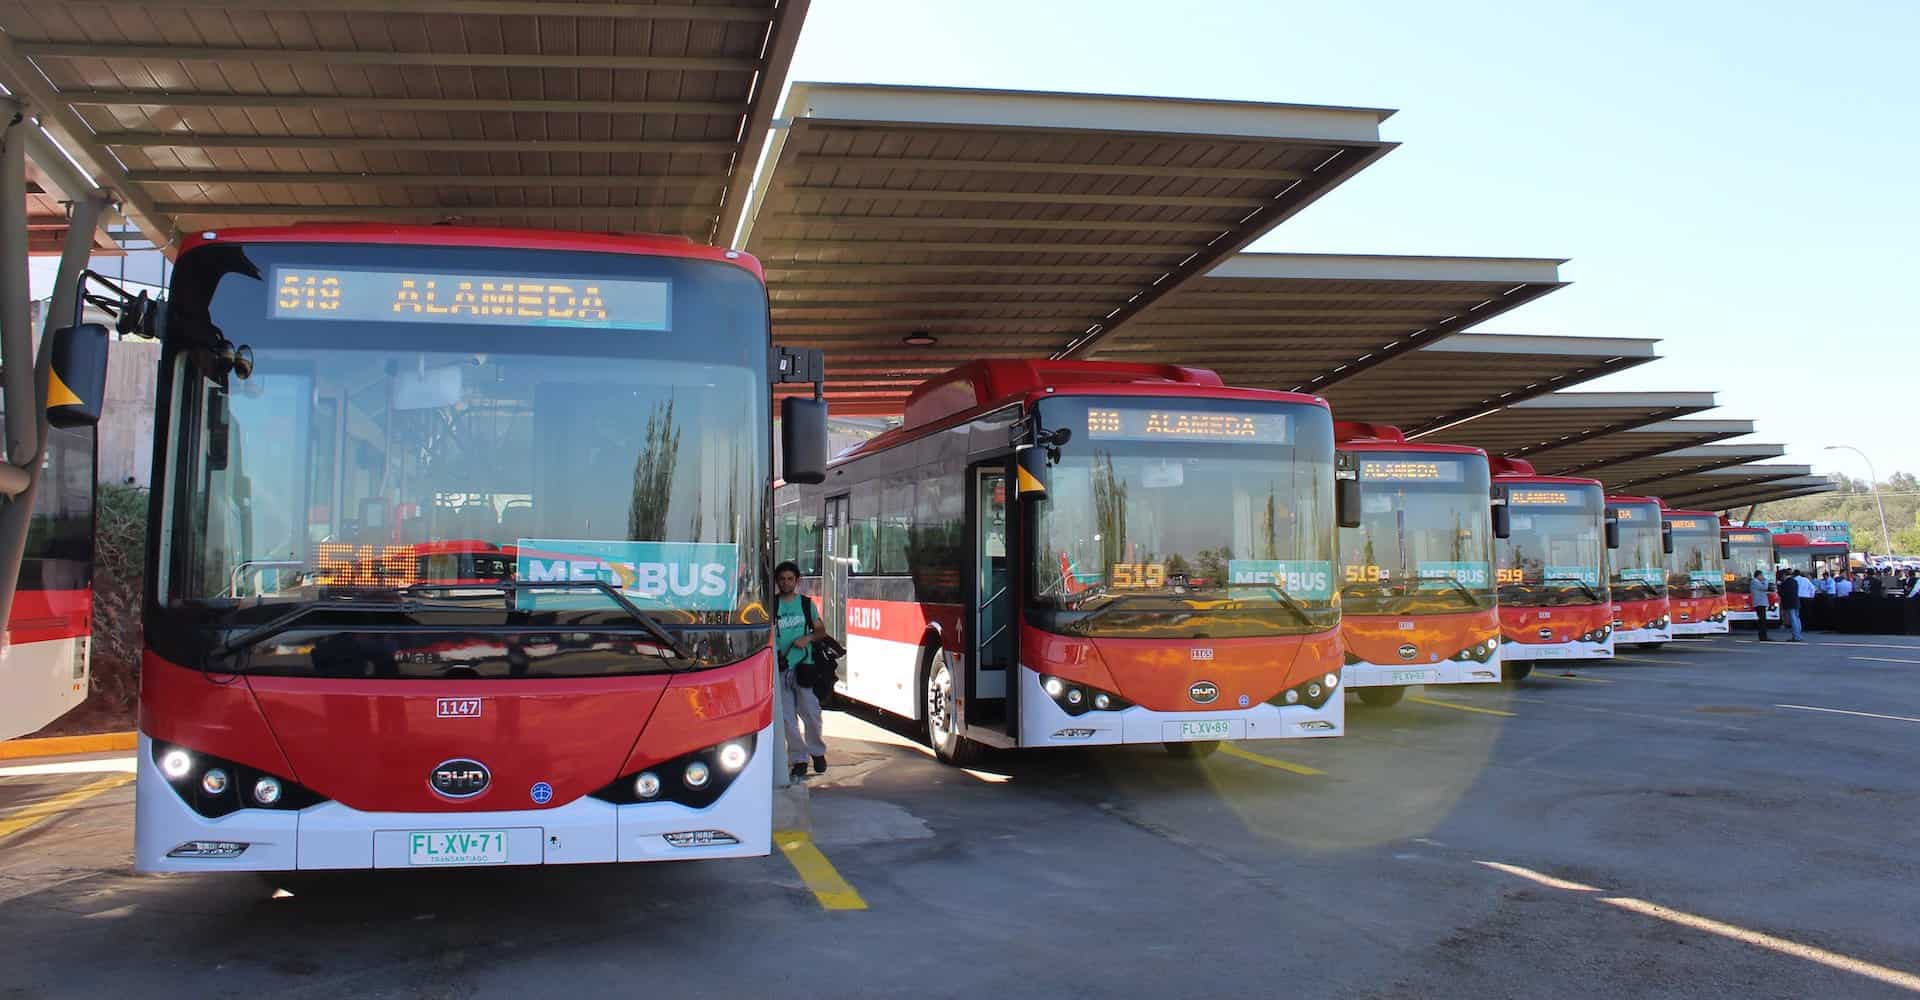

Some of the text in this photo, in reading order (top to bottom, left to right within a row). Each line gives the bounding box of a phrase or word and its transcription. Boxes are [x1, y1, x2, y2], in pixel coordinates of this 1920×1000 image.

[393, 280, 608, 320] ALAMEDA
[1146, 414, 1256, 436] ALAMEDA
[1364, 464, 1440, 478] ALAMEDA
[318, 543, 418, 587] 519
[1346, 565, 1380, 582] 519
[1112, 563, 1165, 588] 519
[1497, 569, 1523, 582] 519
[440, 702, 478, 715] 1147
[437, 771, 483, 787] BYD
